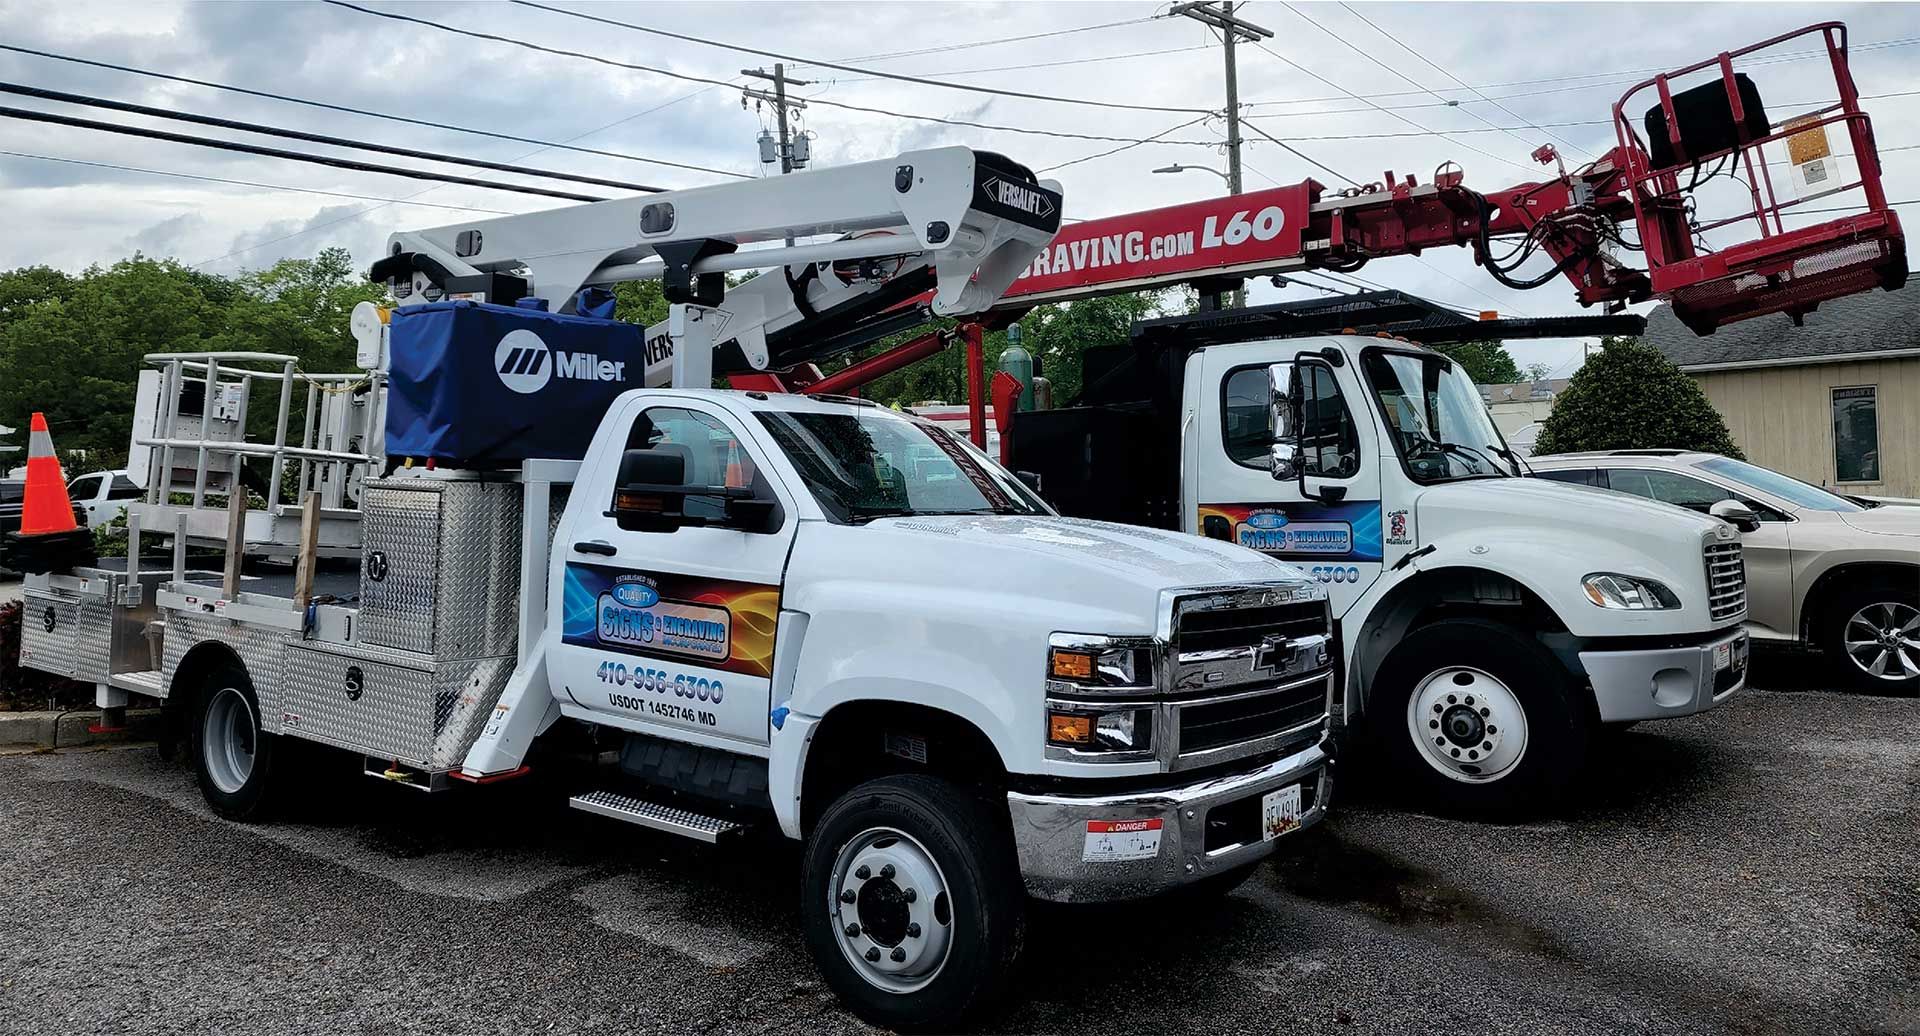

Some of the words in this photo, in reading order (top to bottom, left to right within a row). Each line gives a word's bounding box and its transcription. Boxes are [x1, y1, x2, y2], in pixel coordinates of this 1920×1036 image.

[997, 179, 1041, 215] VERSALIFT
[1017, 231, 1194, 280] RAVING.COM
[1201, 205, 1285, 249] L60
[555, 351, 625, 382] Miller
[1253, 517, 1282, 526] QUALITY
[1294, 530, 1348, 544] ENGRAVING
[615, 574, 647, 584] ESTABLISHED
[617, 587, 653, 602] QUALITY
[663, 615, 725, 644] ENGRAVING
[597, 660, 724, 704] 410-956-6300
[608, 693, 645, 712] USDOT
[648, 701, 695, 722] 1452746
[698, 711, 717, 726] MD
[1115, 822, 1148, 832] DANGER
